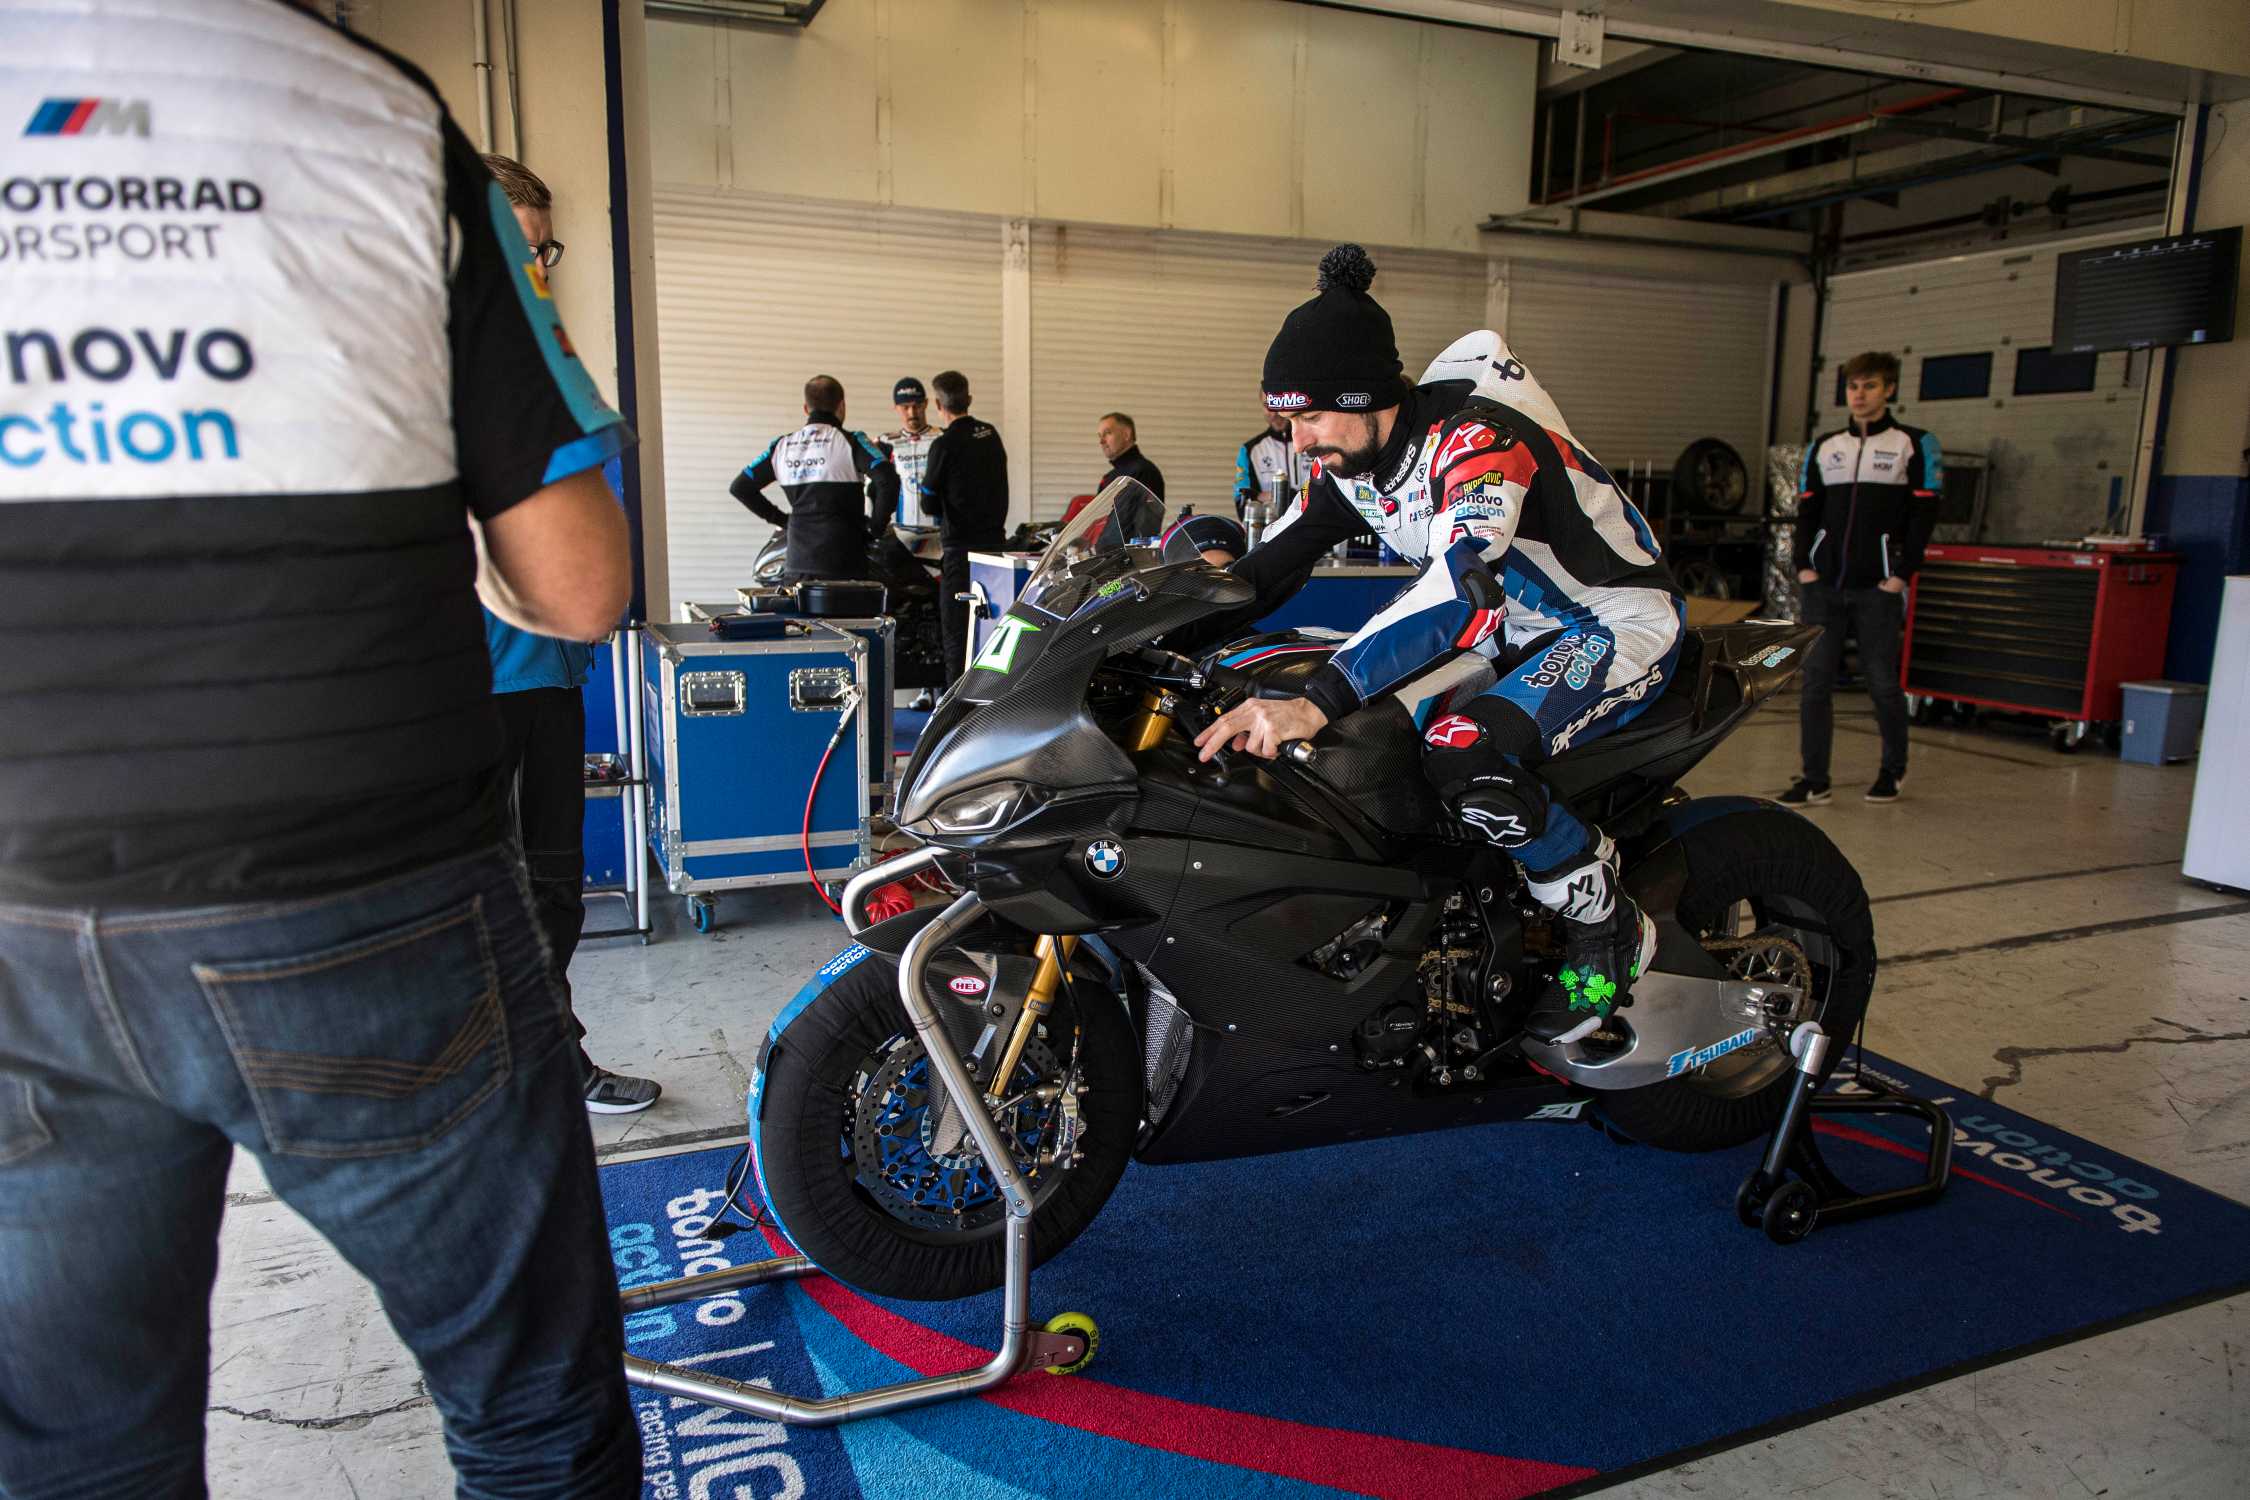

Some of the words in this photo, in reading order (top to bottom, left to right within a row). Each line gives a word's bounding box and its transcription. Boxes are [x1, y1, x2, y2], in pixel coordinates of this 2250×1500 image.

[0, 176, 264, 213] OTORRAD
[0, 222, 220, 261] RSPORT
[1268, 392, 1306, 407] PayMe
[956, 982, 978, 990] HEL
[1689, 1029, 1753, 1069] TSUBAKI
[1959, 1115, 2160, 1200] action
[666, 1188, 747, 1327] bonoo
